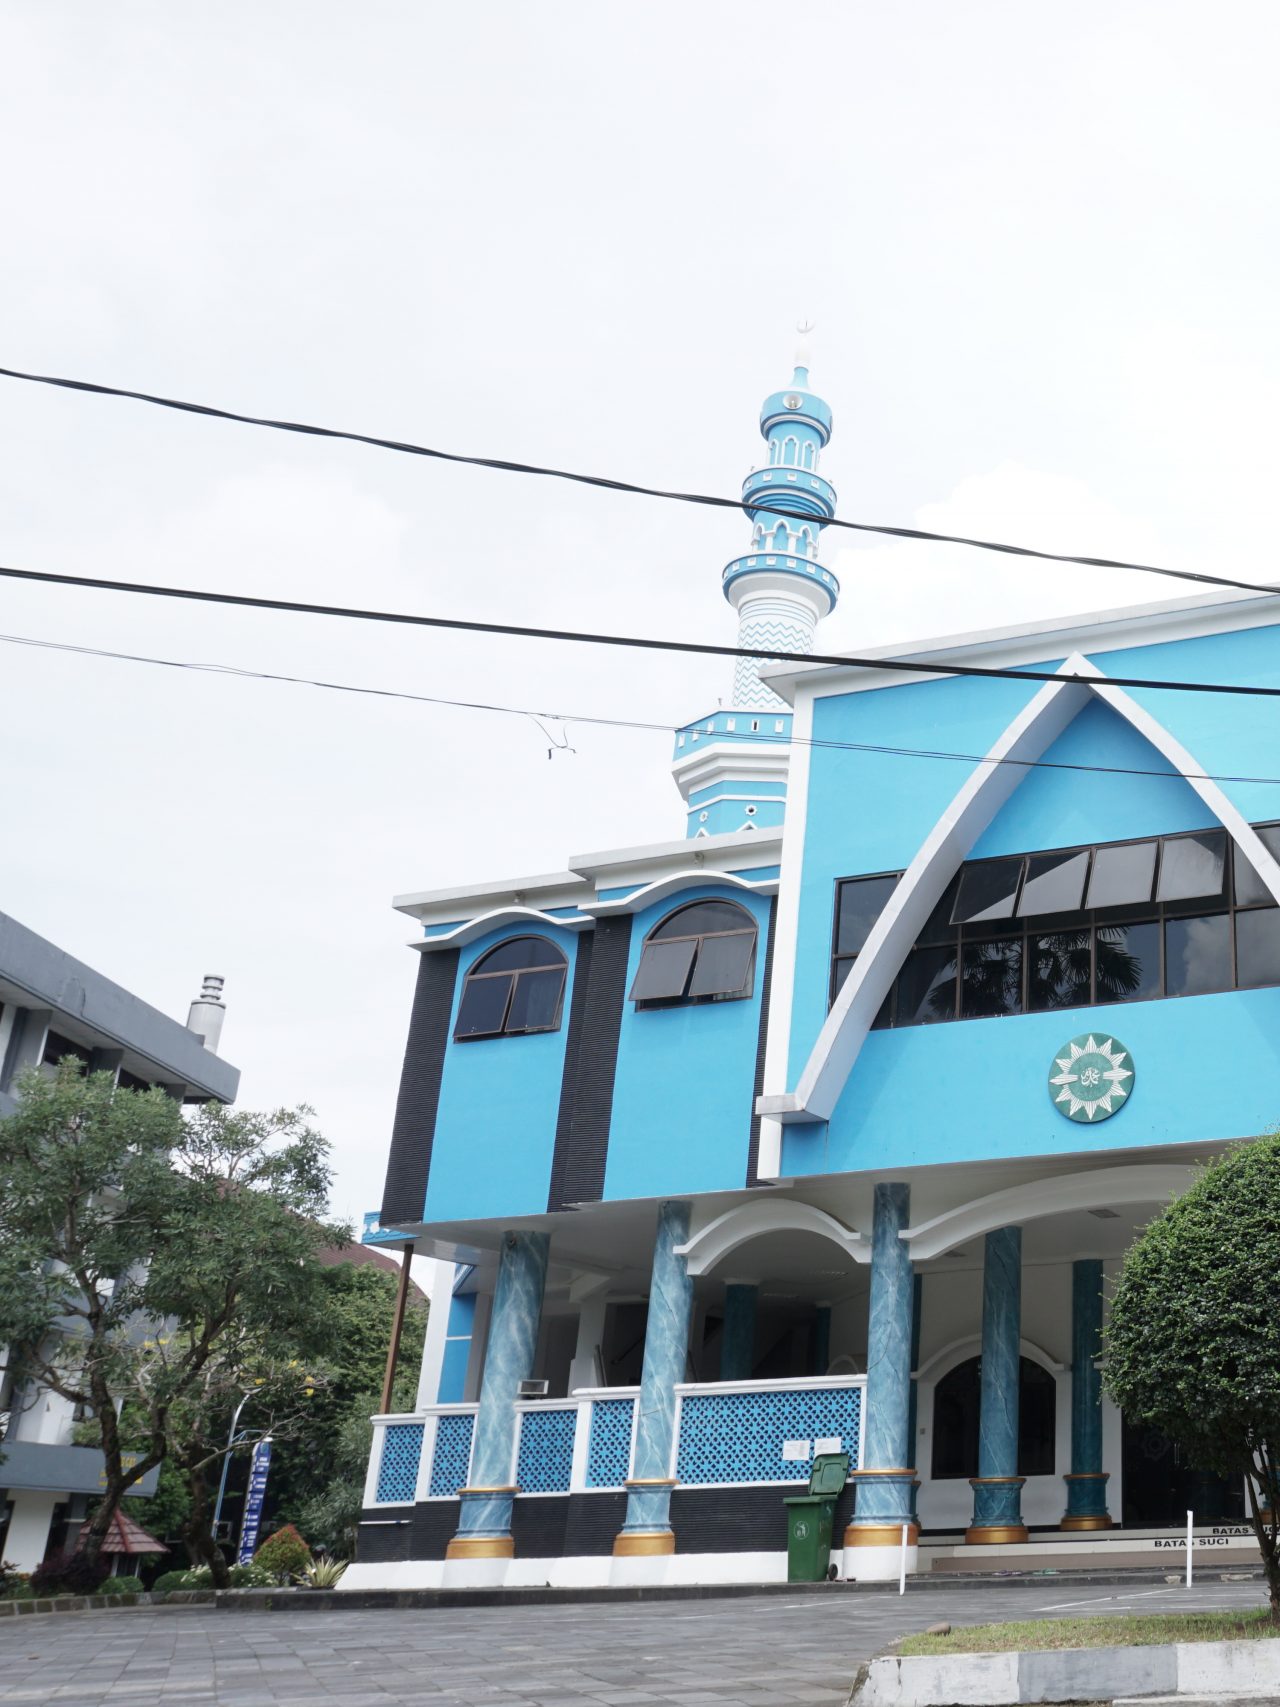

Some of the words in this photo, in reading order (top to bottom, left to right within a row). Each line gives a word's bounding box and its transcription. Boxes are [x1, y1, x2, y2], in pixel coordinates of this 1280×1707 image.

[1212, 1527, 1249, 1535] BATAS
[1154, 1540, 1195, 1548] BATA
[1199, 1538, 1229, 1546] SUCI
